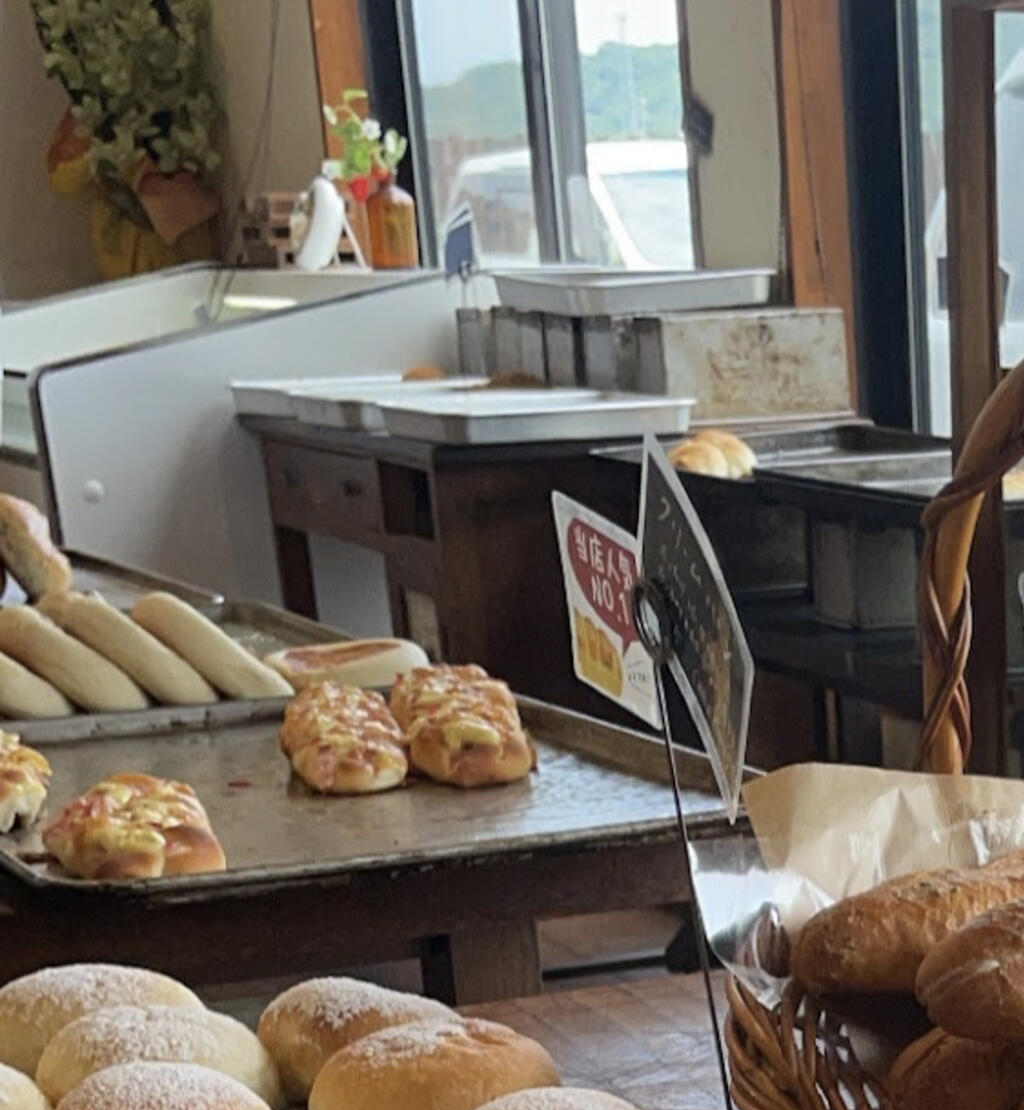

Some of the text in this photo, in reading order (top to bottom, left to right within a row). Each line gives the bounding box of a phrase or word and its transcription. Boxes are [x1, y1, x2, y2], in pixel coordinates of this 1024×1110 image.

[573, 525, 632, 591] 当店人気
[591, 575, 630, 626] NO.1
